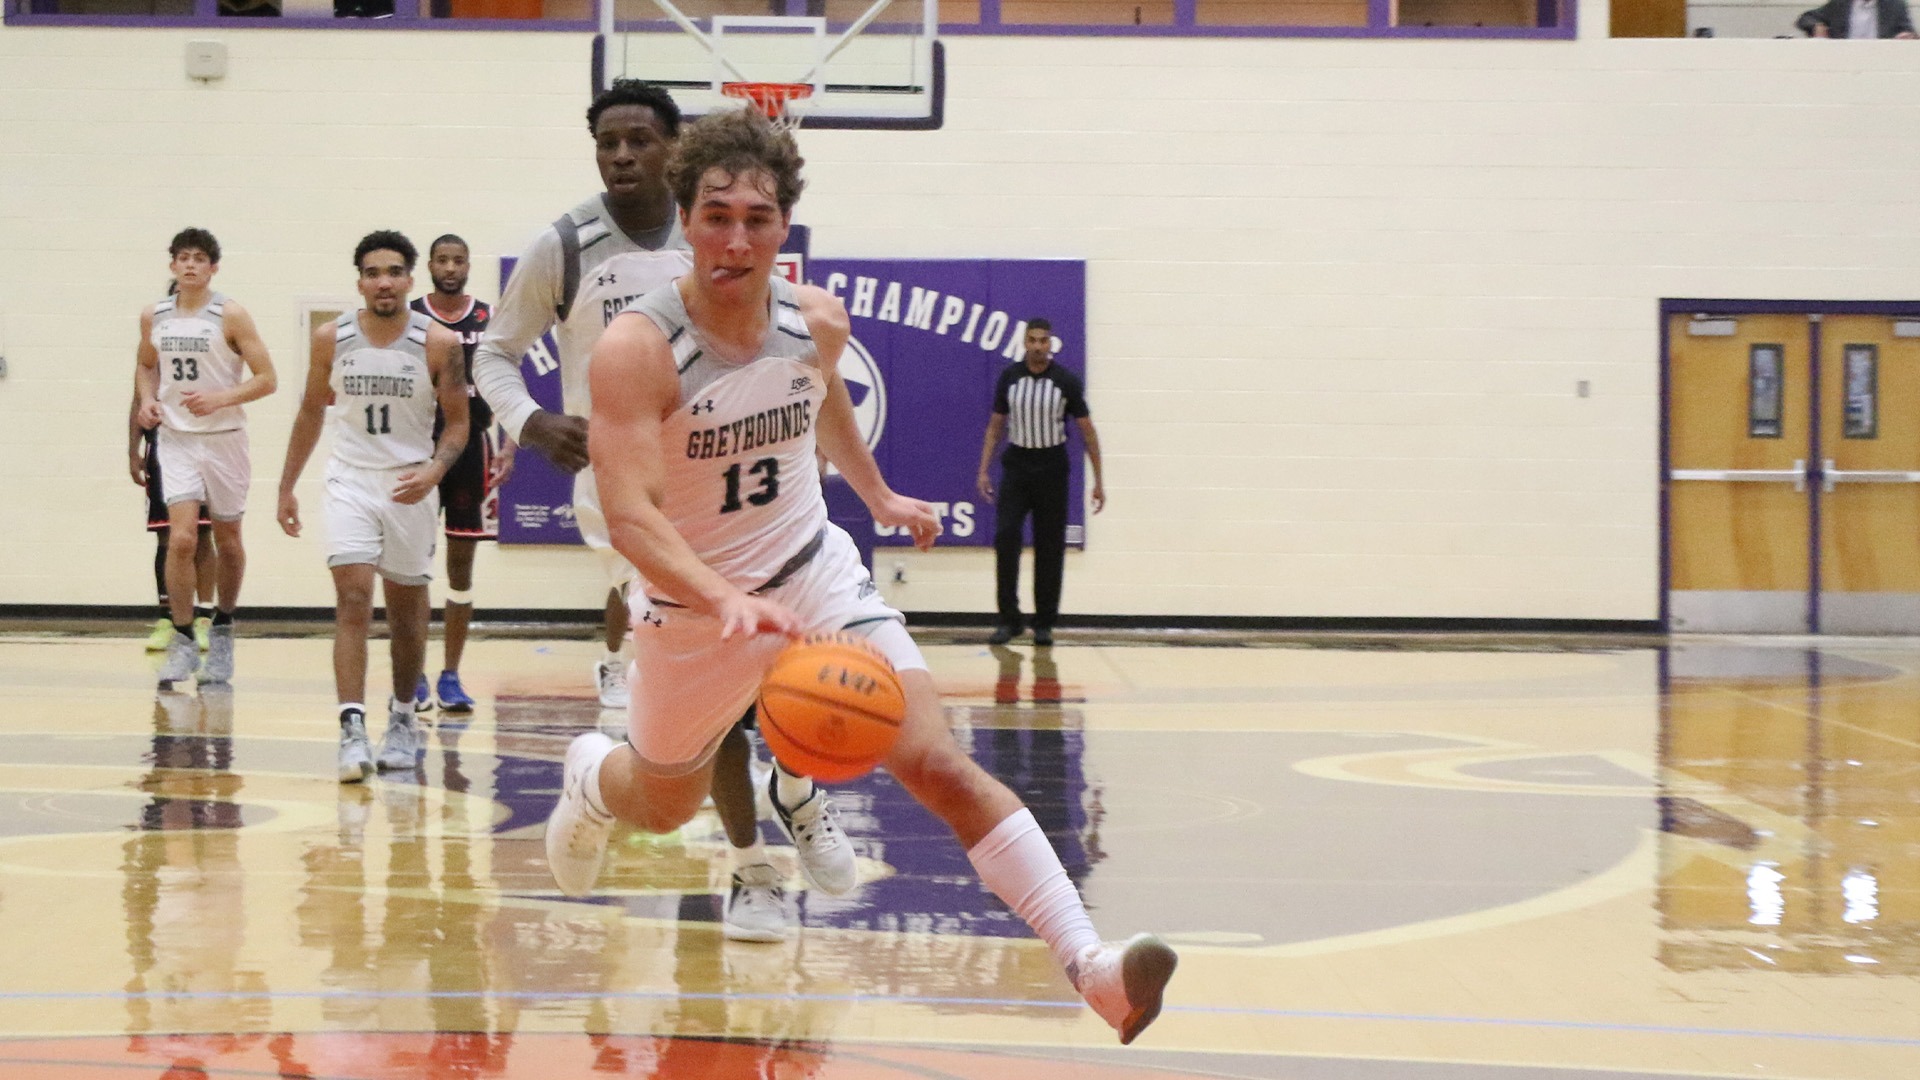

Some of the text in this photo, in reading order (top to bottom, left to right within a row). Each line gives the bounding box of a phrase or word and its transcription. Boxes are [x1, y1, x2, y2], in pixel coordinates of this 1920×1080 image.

[172, 358, 199, 381] 33
[343, 375, 413, 398] GREYHOUNDS
[364, 404, 392, 435] 11
[687, 399, 811, 459] GREYHOUNDS
[720, 457, 780, 514] 13
